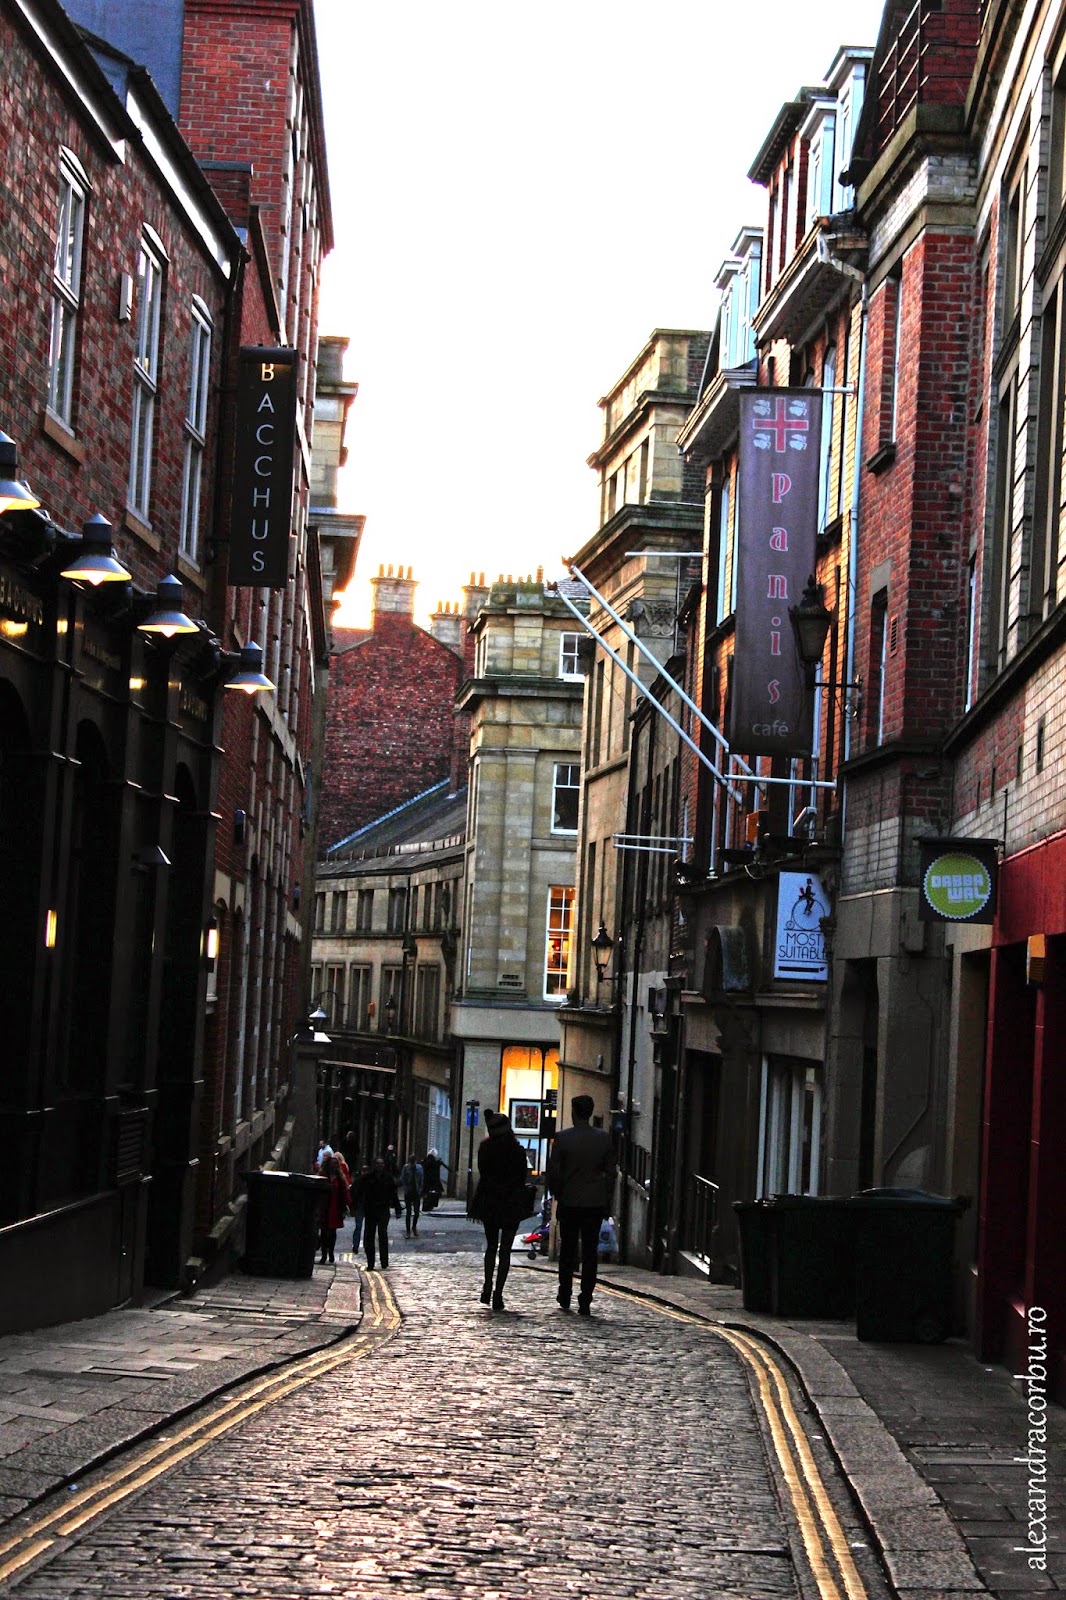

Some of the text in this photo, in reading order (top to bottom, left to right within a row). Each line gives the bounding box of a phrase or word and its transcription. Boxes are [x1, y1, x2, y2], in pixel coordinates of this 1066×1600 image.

[252, 362, 277, 573] BACCHUS
[767, 472, 792, 705] Panis
[751, 719, 789, 737] café
[931, 874, 984, 888] DABBA
[947, 886, 989, 900] WAL
[786, 932, 822, 946] MOST
